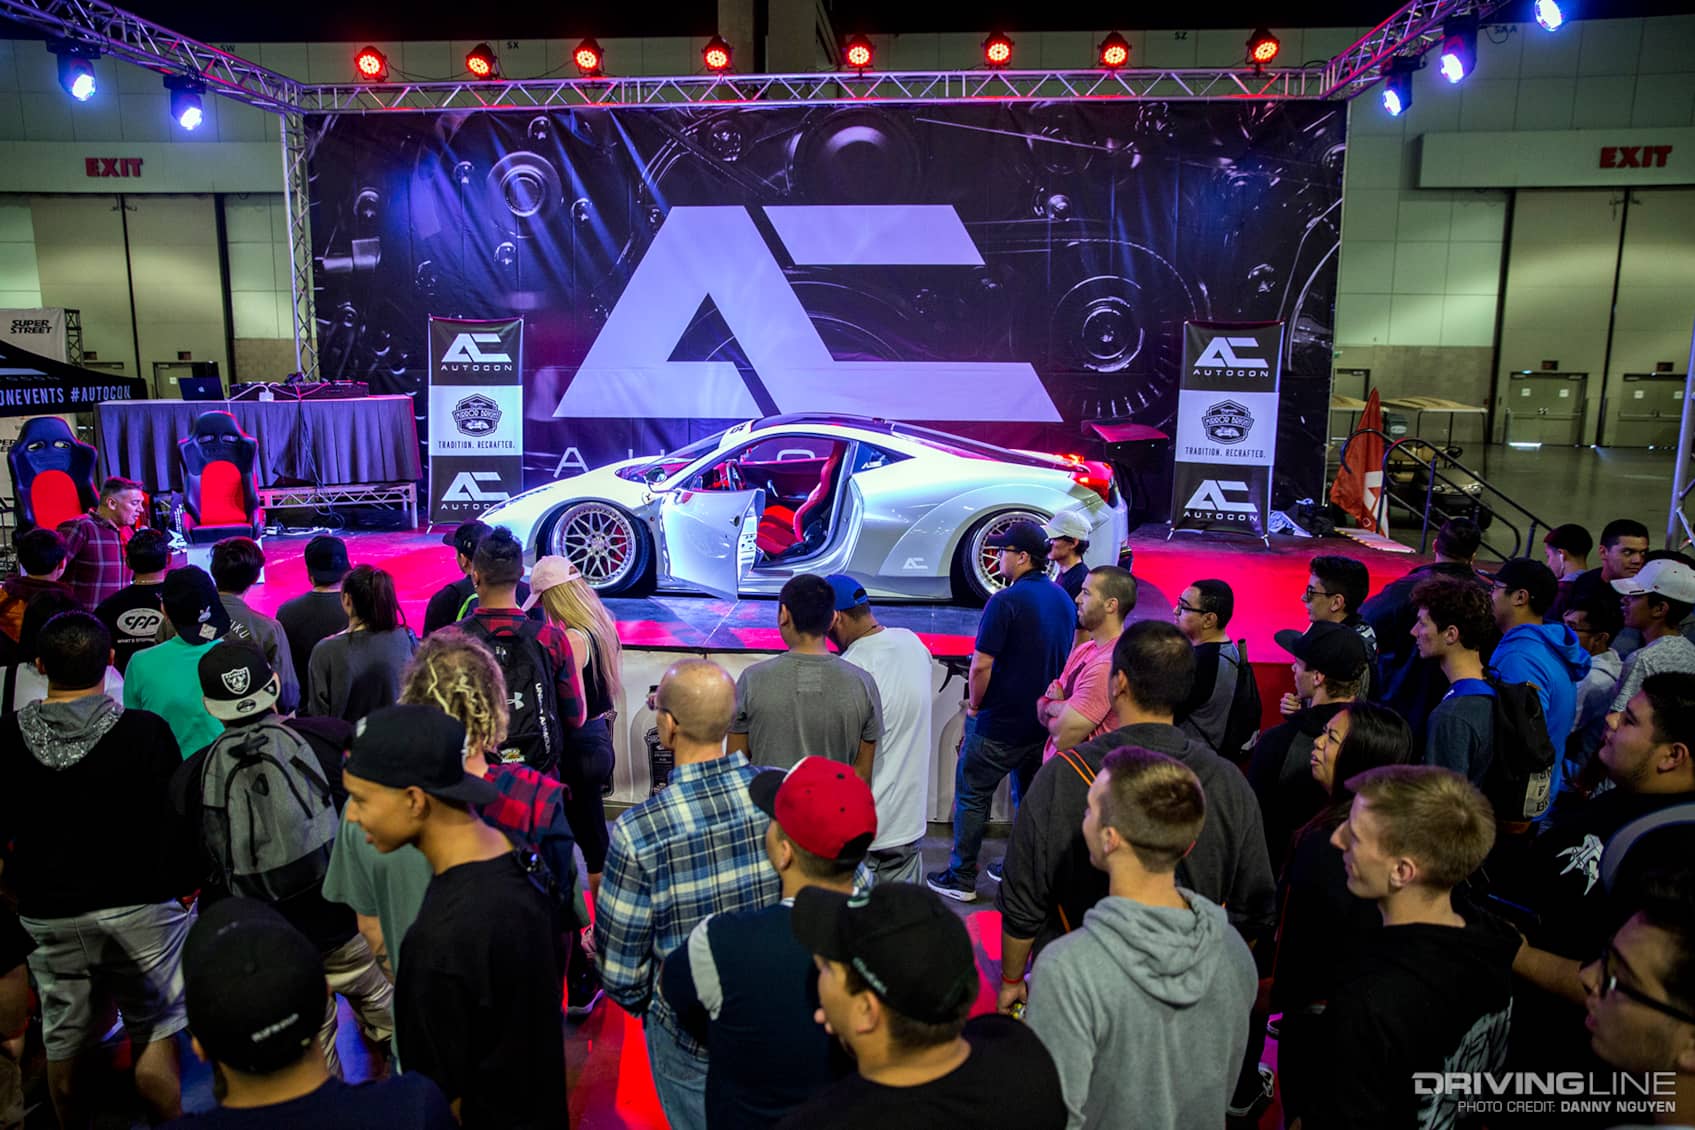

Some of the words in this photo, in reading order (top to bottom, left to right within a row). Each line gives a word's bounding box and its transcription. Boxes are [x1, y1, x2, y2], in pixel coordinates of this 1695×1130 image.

[1599, 145, 1673, 169] EXIT
[84, 157, 144, 177] EXIT
[10, 326, 52, 334] STREET
[440, 364, 513, 372] AUTOCON
[1192, 369, 1269, 377] AUTOCON
[70, 385, 131, 402] #AUTOCON
[1183, 511, 1259, 522] AUTOCON
